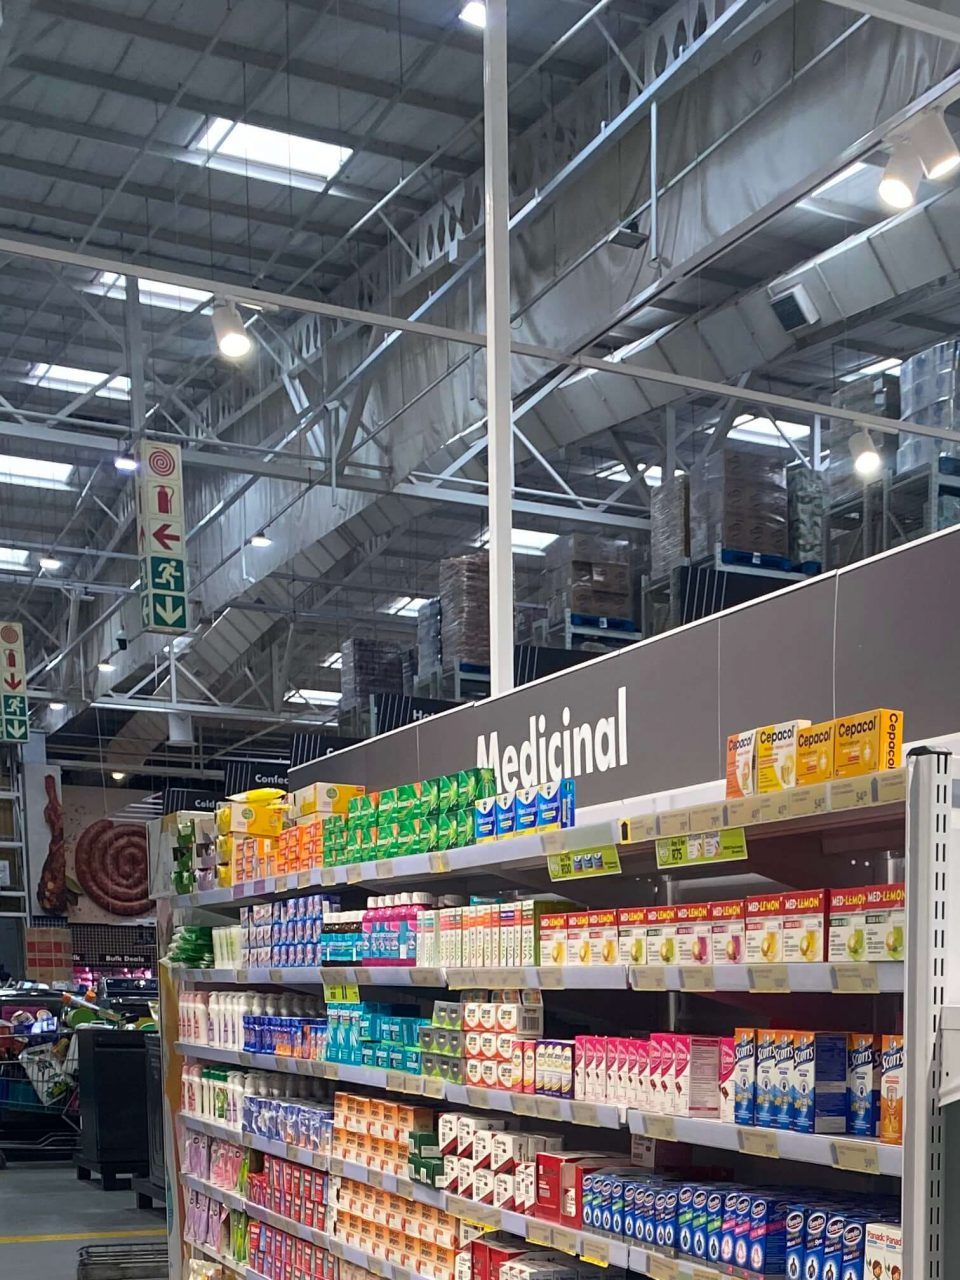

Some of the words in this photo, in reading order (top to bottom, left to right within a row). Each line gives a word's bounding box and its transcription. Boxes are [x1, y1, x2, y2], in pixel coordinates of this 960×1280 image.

[760, 725, 795, 745] Cepacol
[838, 716, 877, 738] Cepacol
[475, 685, 628, 796] Medicinal
[728, 733, 754, 752] Cepacol
[798, 727, 832, 748] Cepacol
[748, 900, 780, 912] MED-LEMON
[785, 898, 819, 909] MED-LEMON
